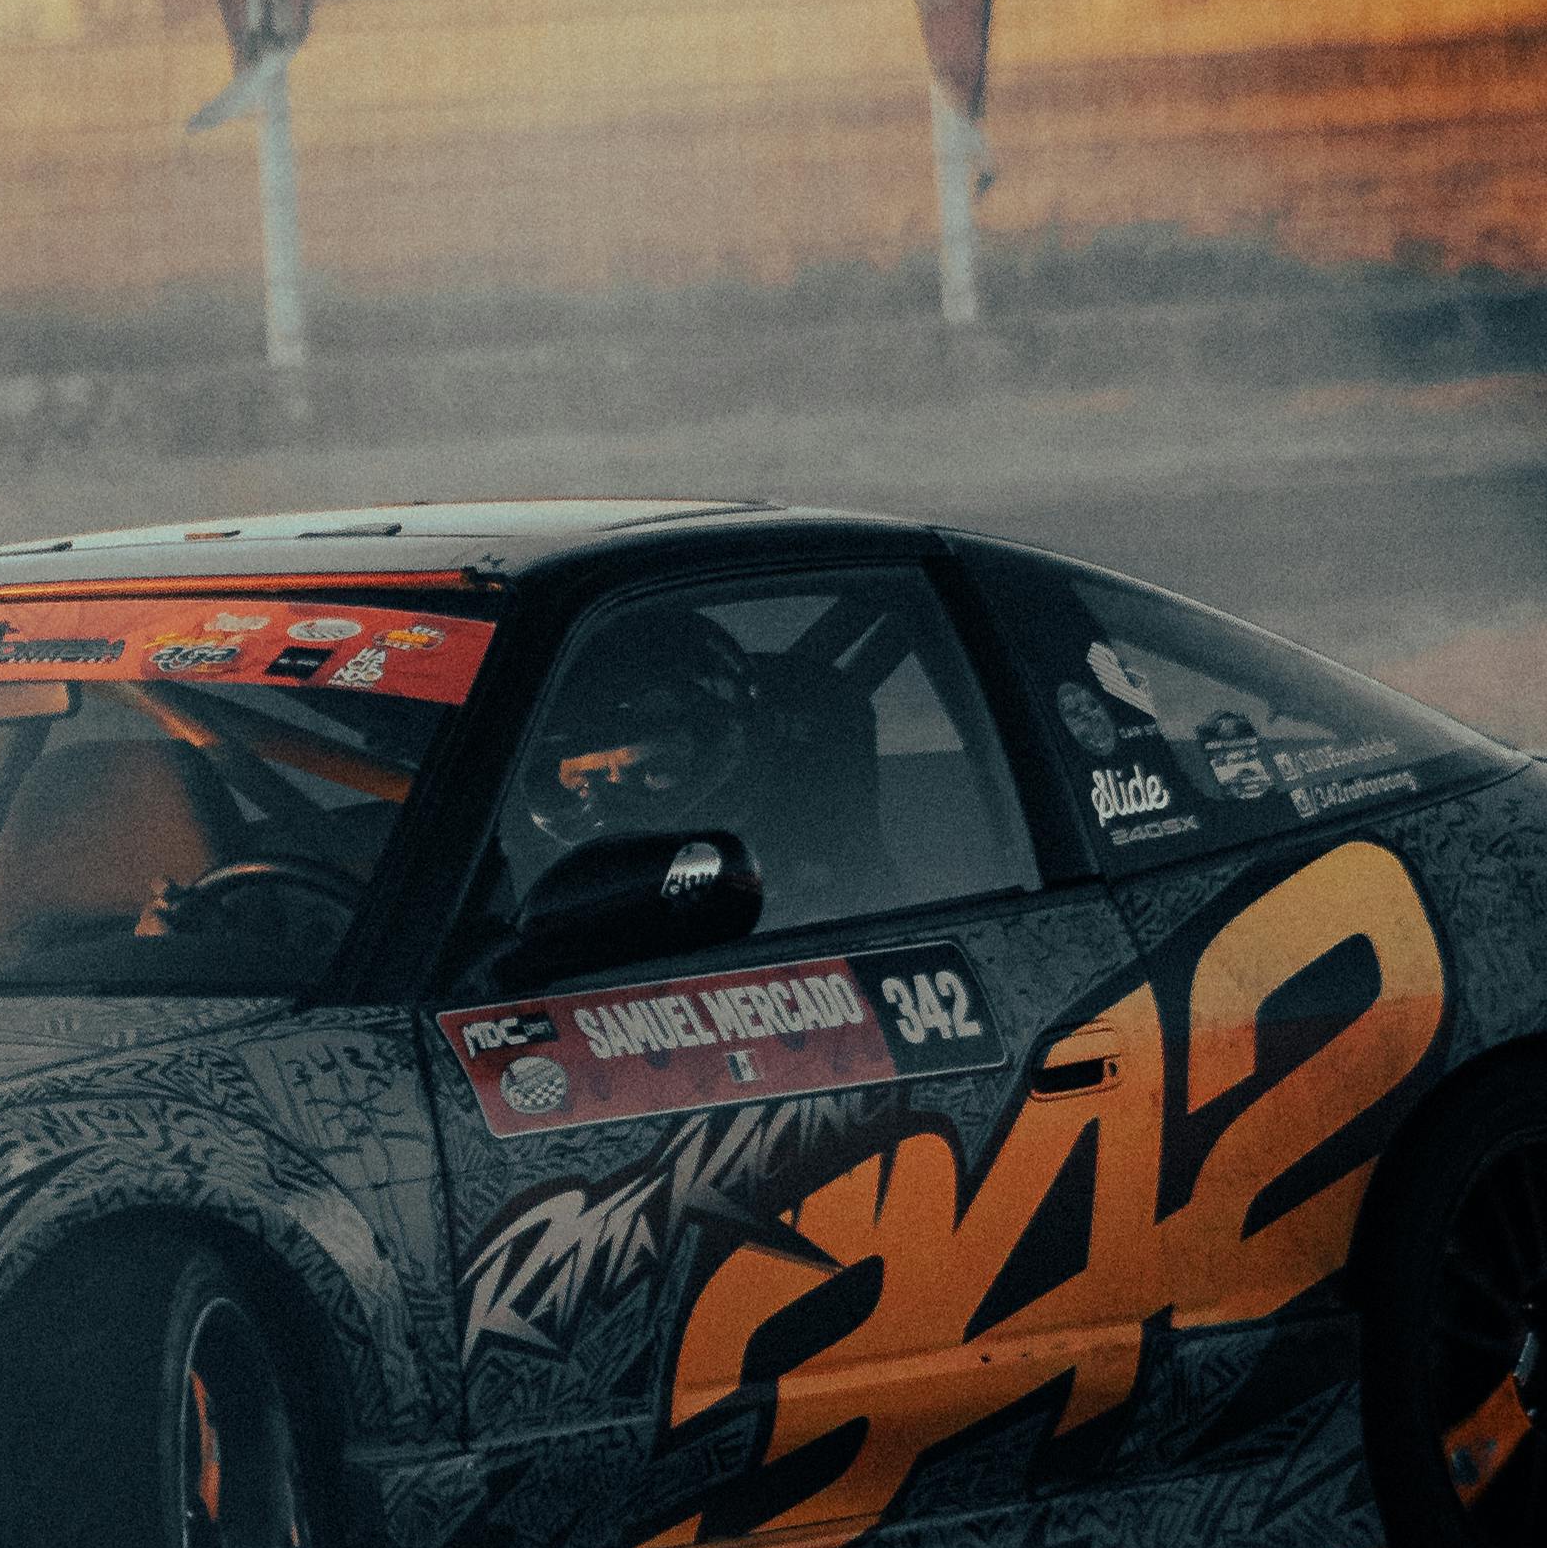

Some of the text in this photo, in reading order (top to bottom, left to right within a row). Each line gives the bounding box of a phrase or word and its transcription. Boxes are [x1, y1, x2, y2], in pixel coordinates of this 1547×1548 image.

[1092, 762, 1171, 826] Slide
[1110, 814, 1201, 846] 240SX
[462, 1017, 529, 1059] MDC
[574, 973, 865, 1061] SAMUEL MERCADO
[883, 970, 983, 1045] 342
